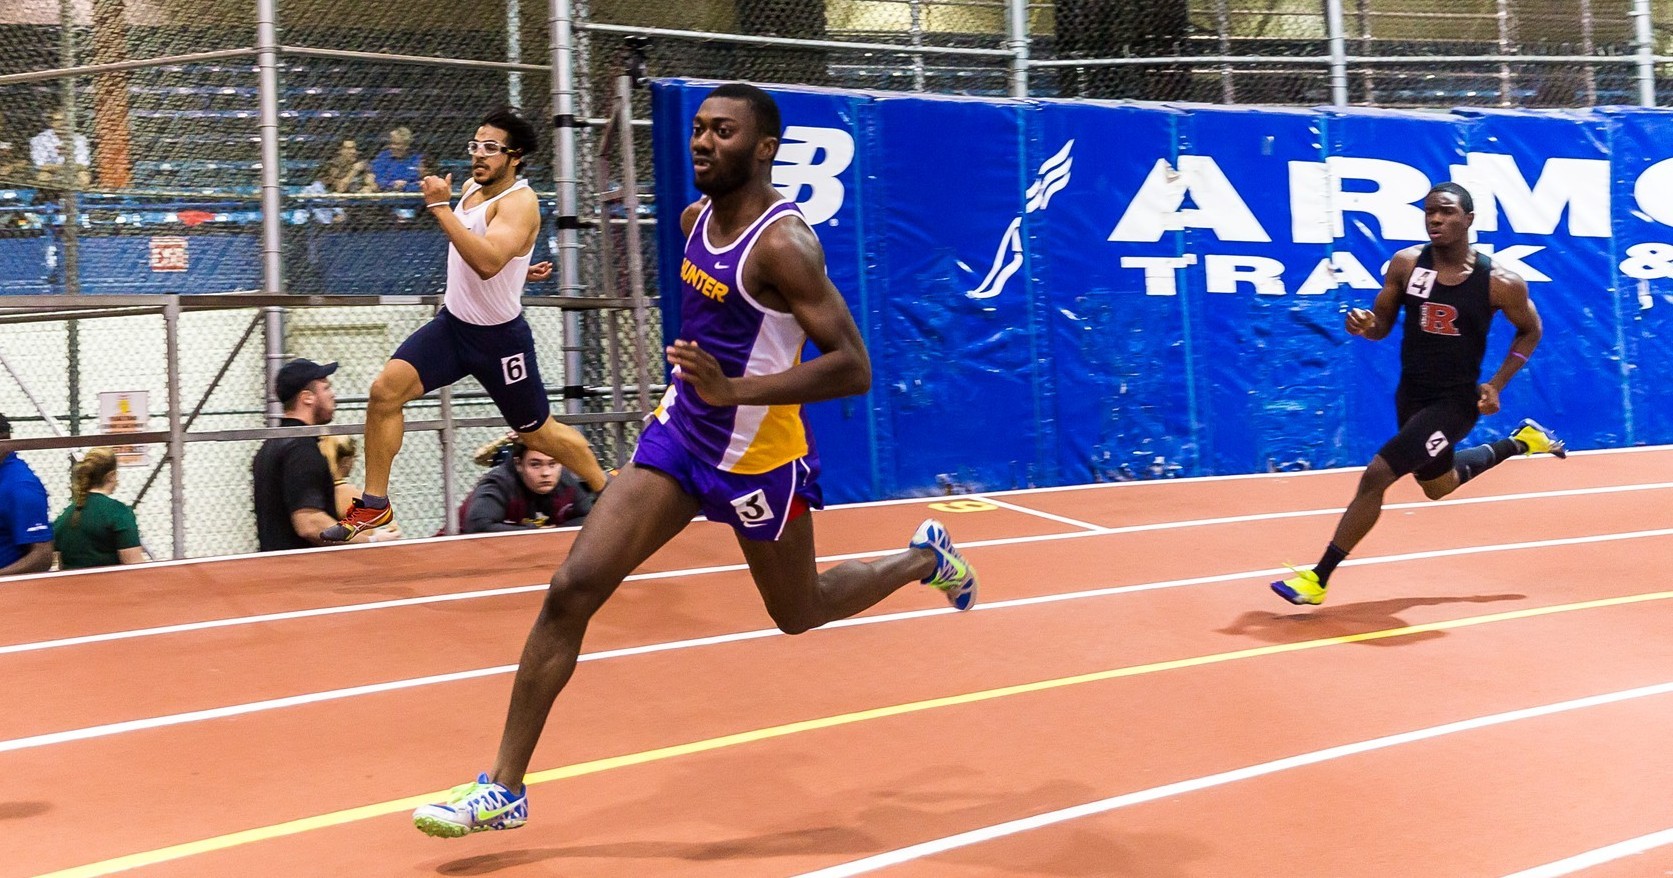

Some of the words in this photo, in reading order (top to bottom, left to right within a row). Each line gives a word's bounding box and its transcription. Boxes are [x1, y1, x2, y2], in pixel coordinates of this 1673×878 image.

[681, 257, 729, 303] UNTER
[1120, 244, 1551, 296] TRAK
[1411, 271, 1431, 295] 4
[1420, 301, 1461, 336] R
[506, 356, 523, 381] 6
[740, 493, 765, 520] 3
